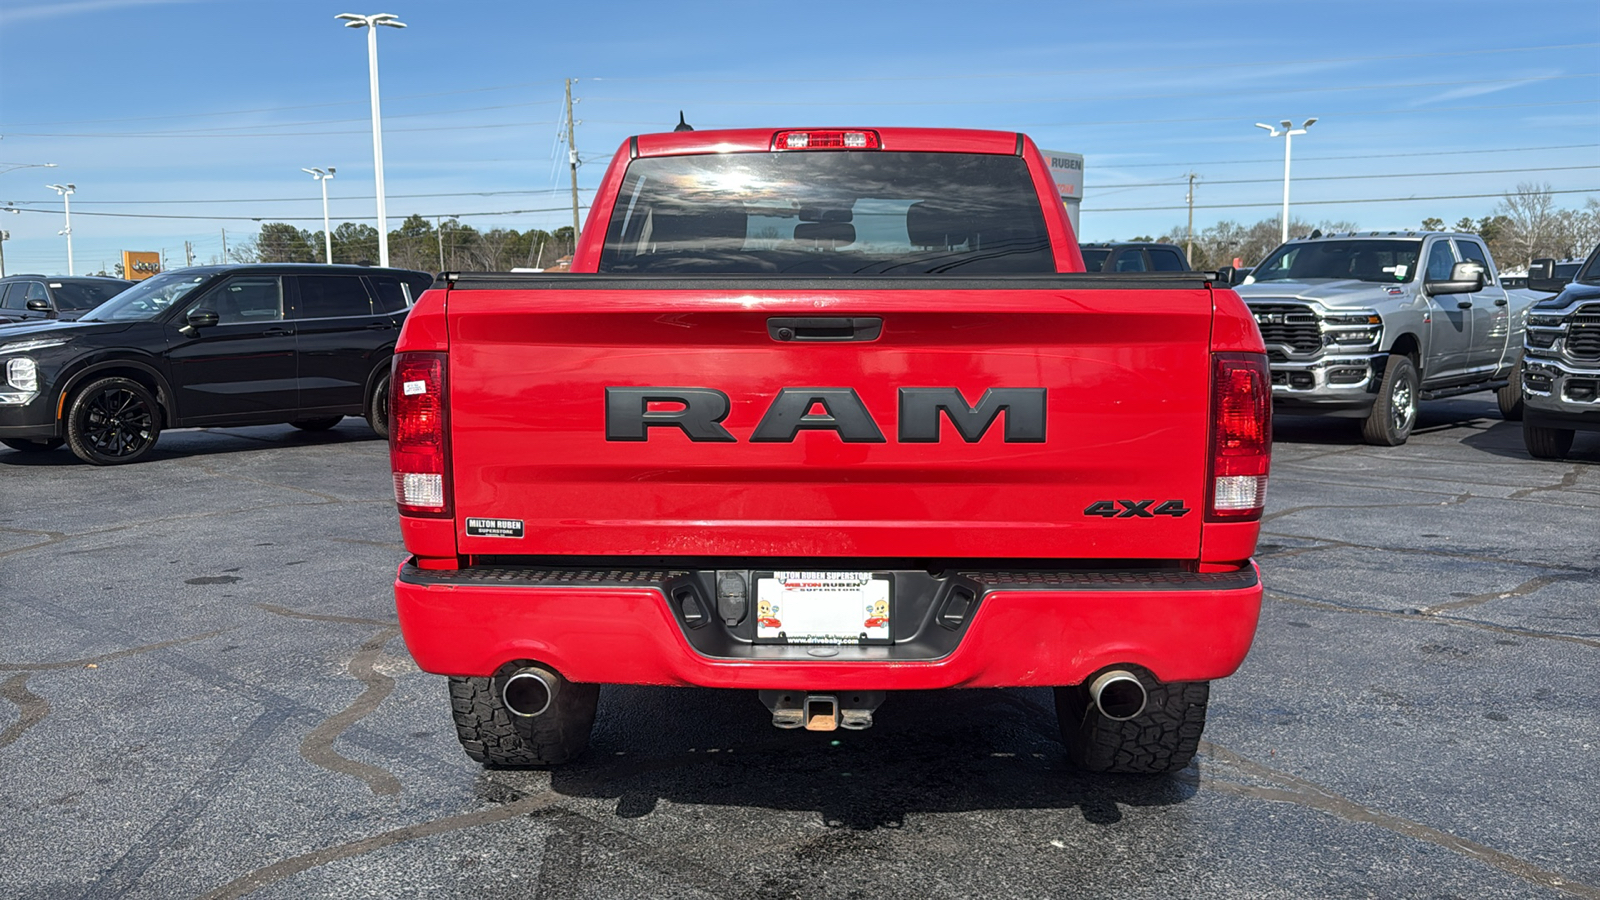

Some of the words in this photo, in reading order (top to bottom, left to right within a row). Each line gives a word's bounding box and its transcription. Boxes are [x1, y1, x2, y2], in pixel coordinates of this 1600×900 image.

[1051, 157, 1081, 170] RUBEN
[132, 259, 159, 272] Jeep
[604, 386, 1048, 443] RAM
[469, 519, 496, 528] MILTON
[497, 520, 521, 529] RUBEN
[773, 571, 800, 580] MILTON
[801, 571, 826, 580] RUBEN
[826, 571, 873, 580] SUPERSTORE
